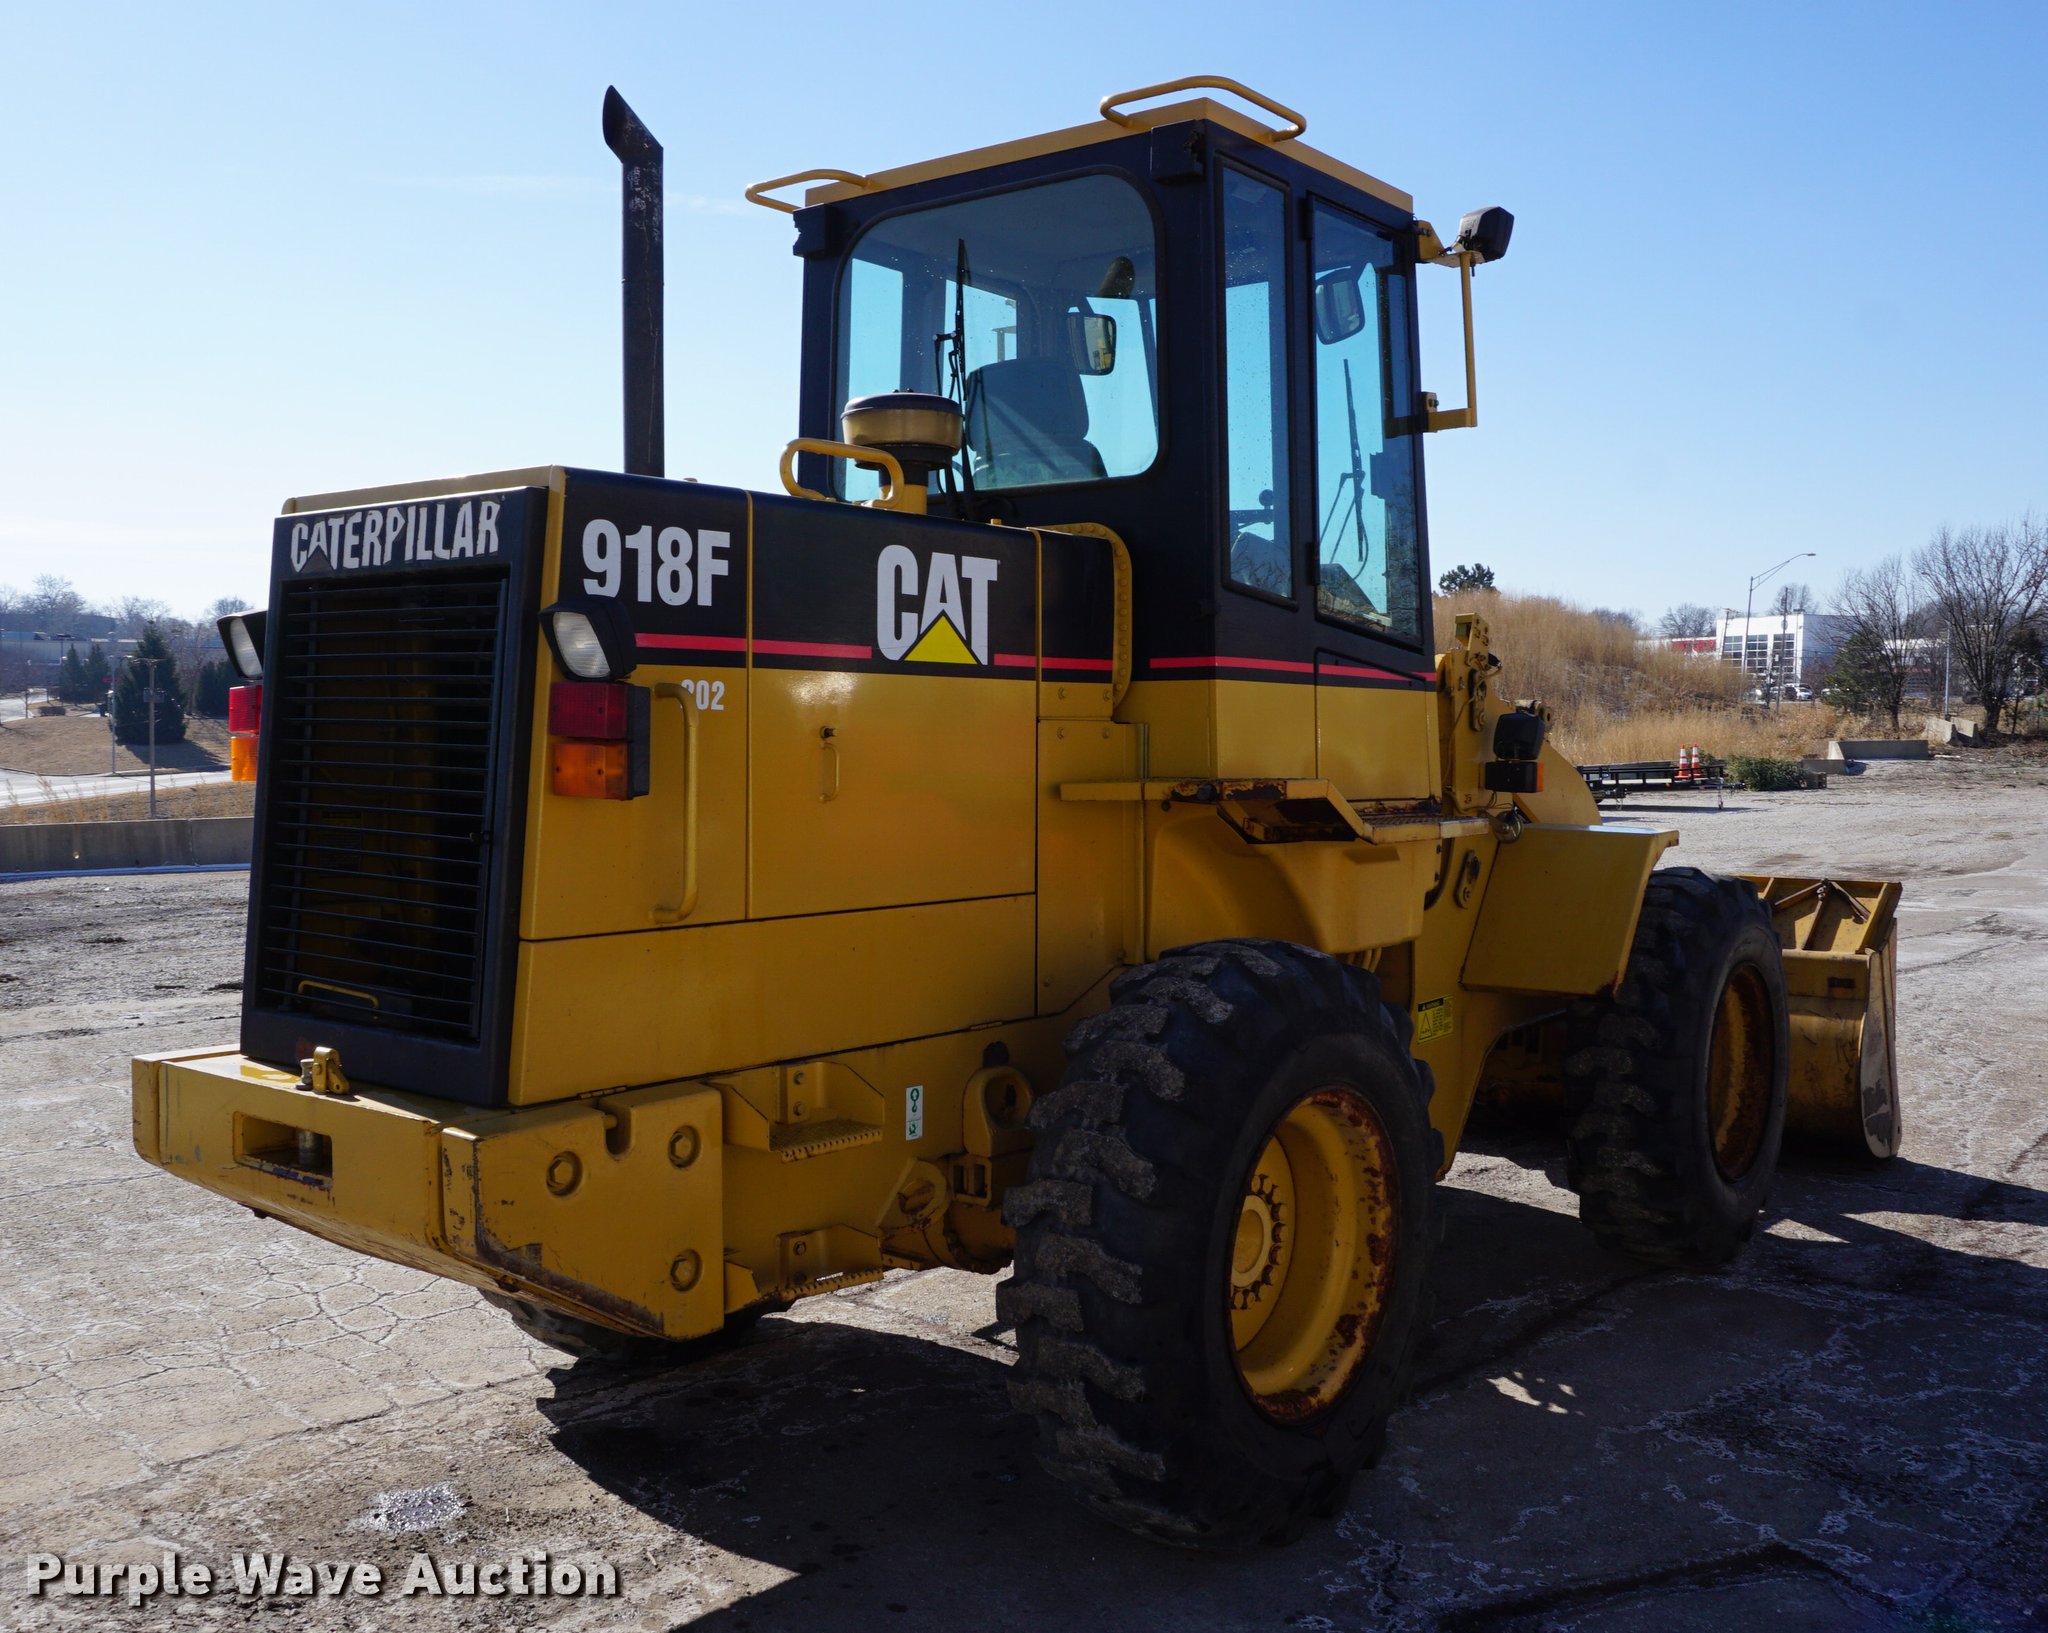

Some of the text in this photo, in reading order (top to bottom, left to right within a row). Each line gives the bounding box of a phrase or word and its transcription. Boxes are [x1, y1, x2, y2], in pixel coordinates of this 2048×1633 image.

[290, 500, 501, 573] CATERPILLAR
[582, 518, 731, 607] 918F
[877, 544, 998, 666] CAT
